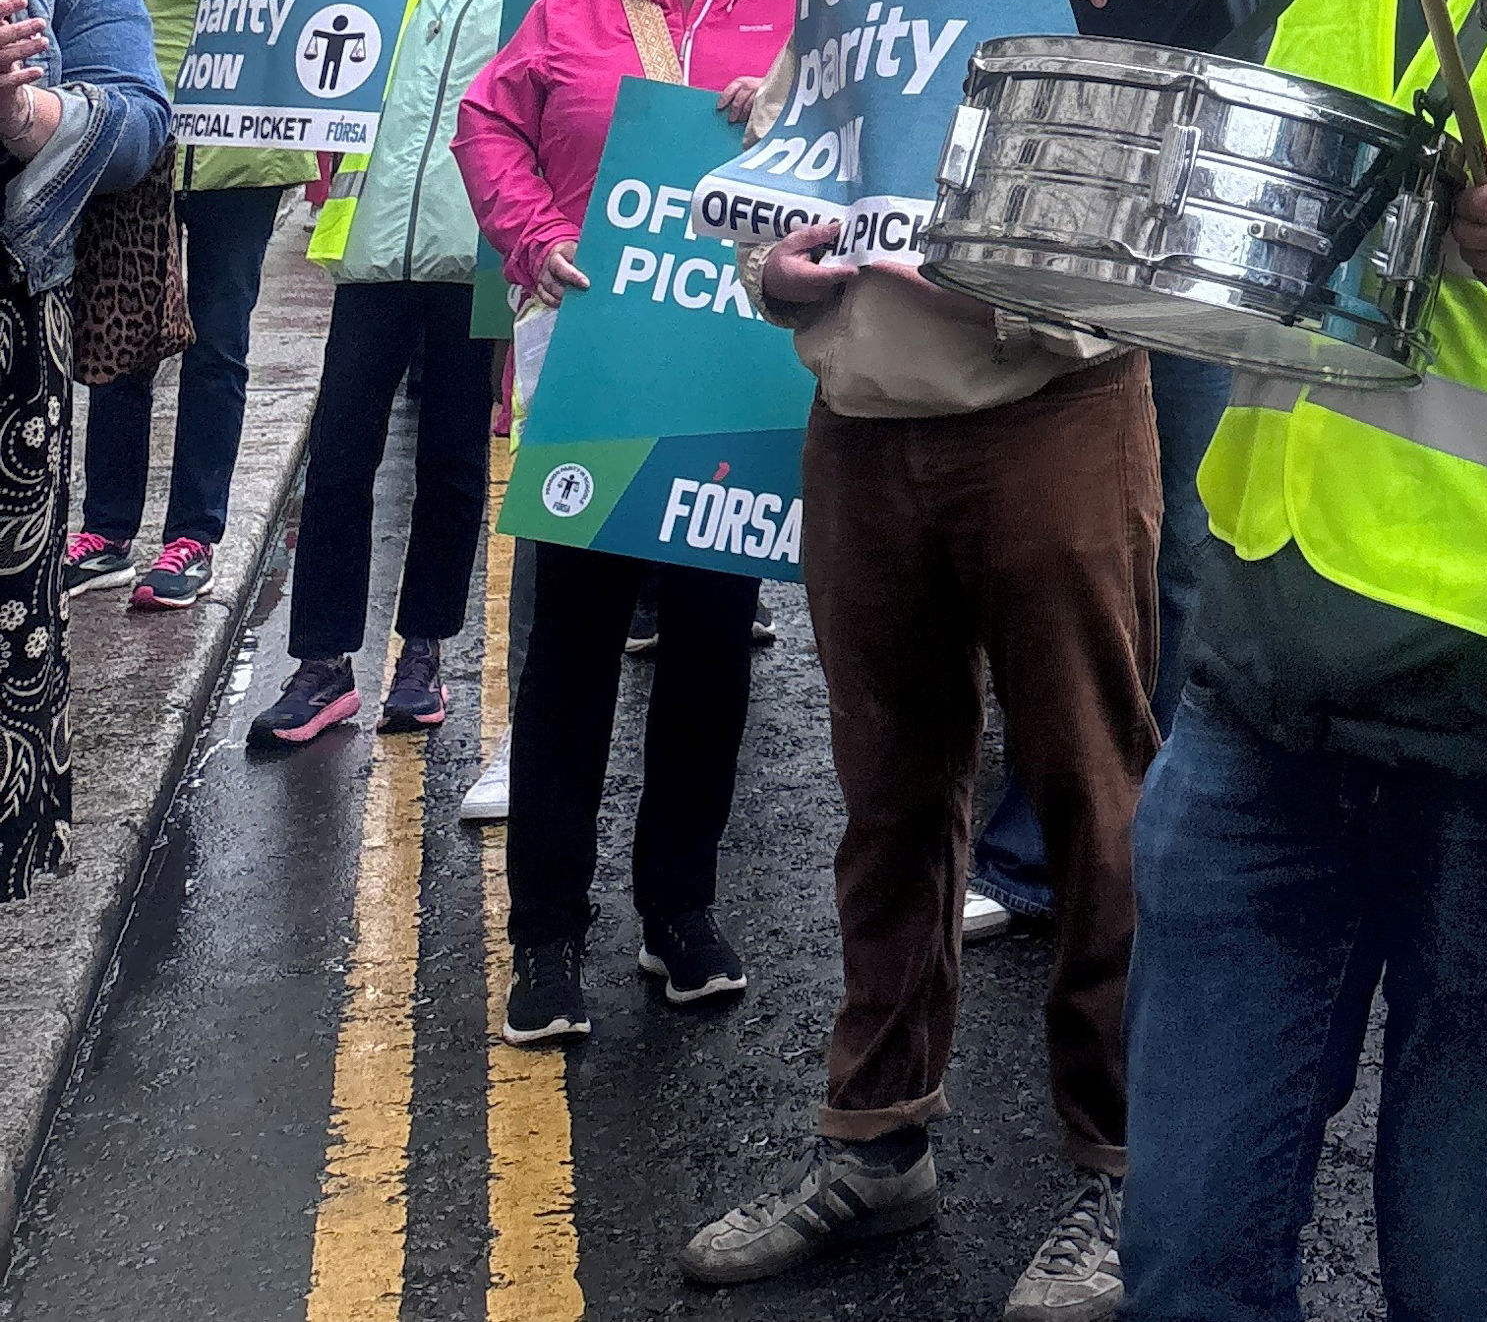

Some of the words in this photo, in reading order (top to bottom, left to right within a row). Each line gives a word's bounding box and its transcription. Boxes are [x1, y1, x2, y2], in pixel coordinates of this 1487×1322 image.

[178, 53, 244, 89] now
[784, 1, 968, 127] parity
[171, 113, 234, 138] OFFICIAL
[238, 115, 312, 141] PICKET
[612, 245, 764, 321] PICK
